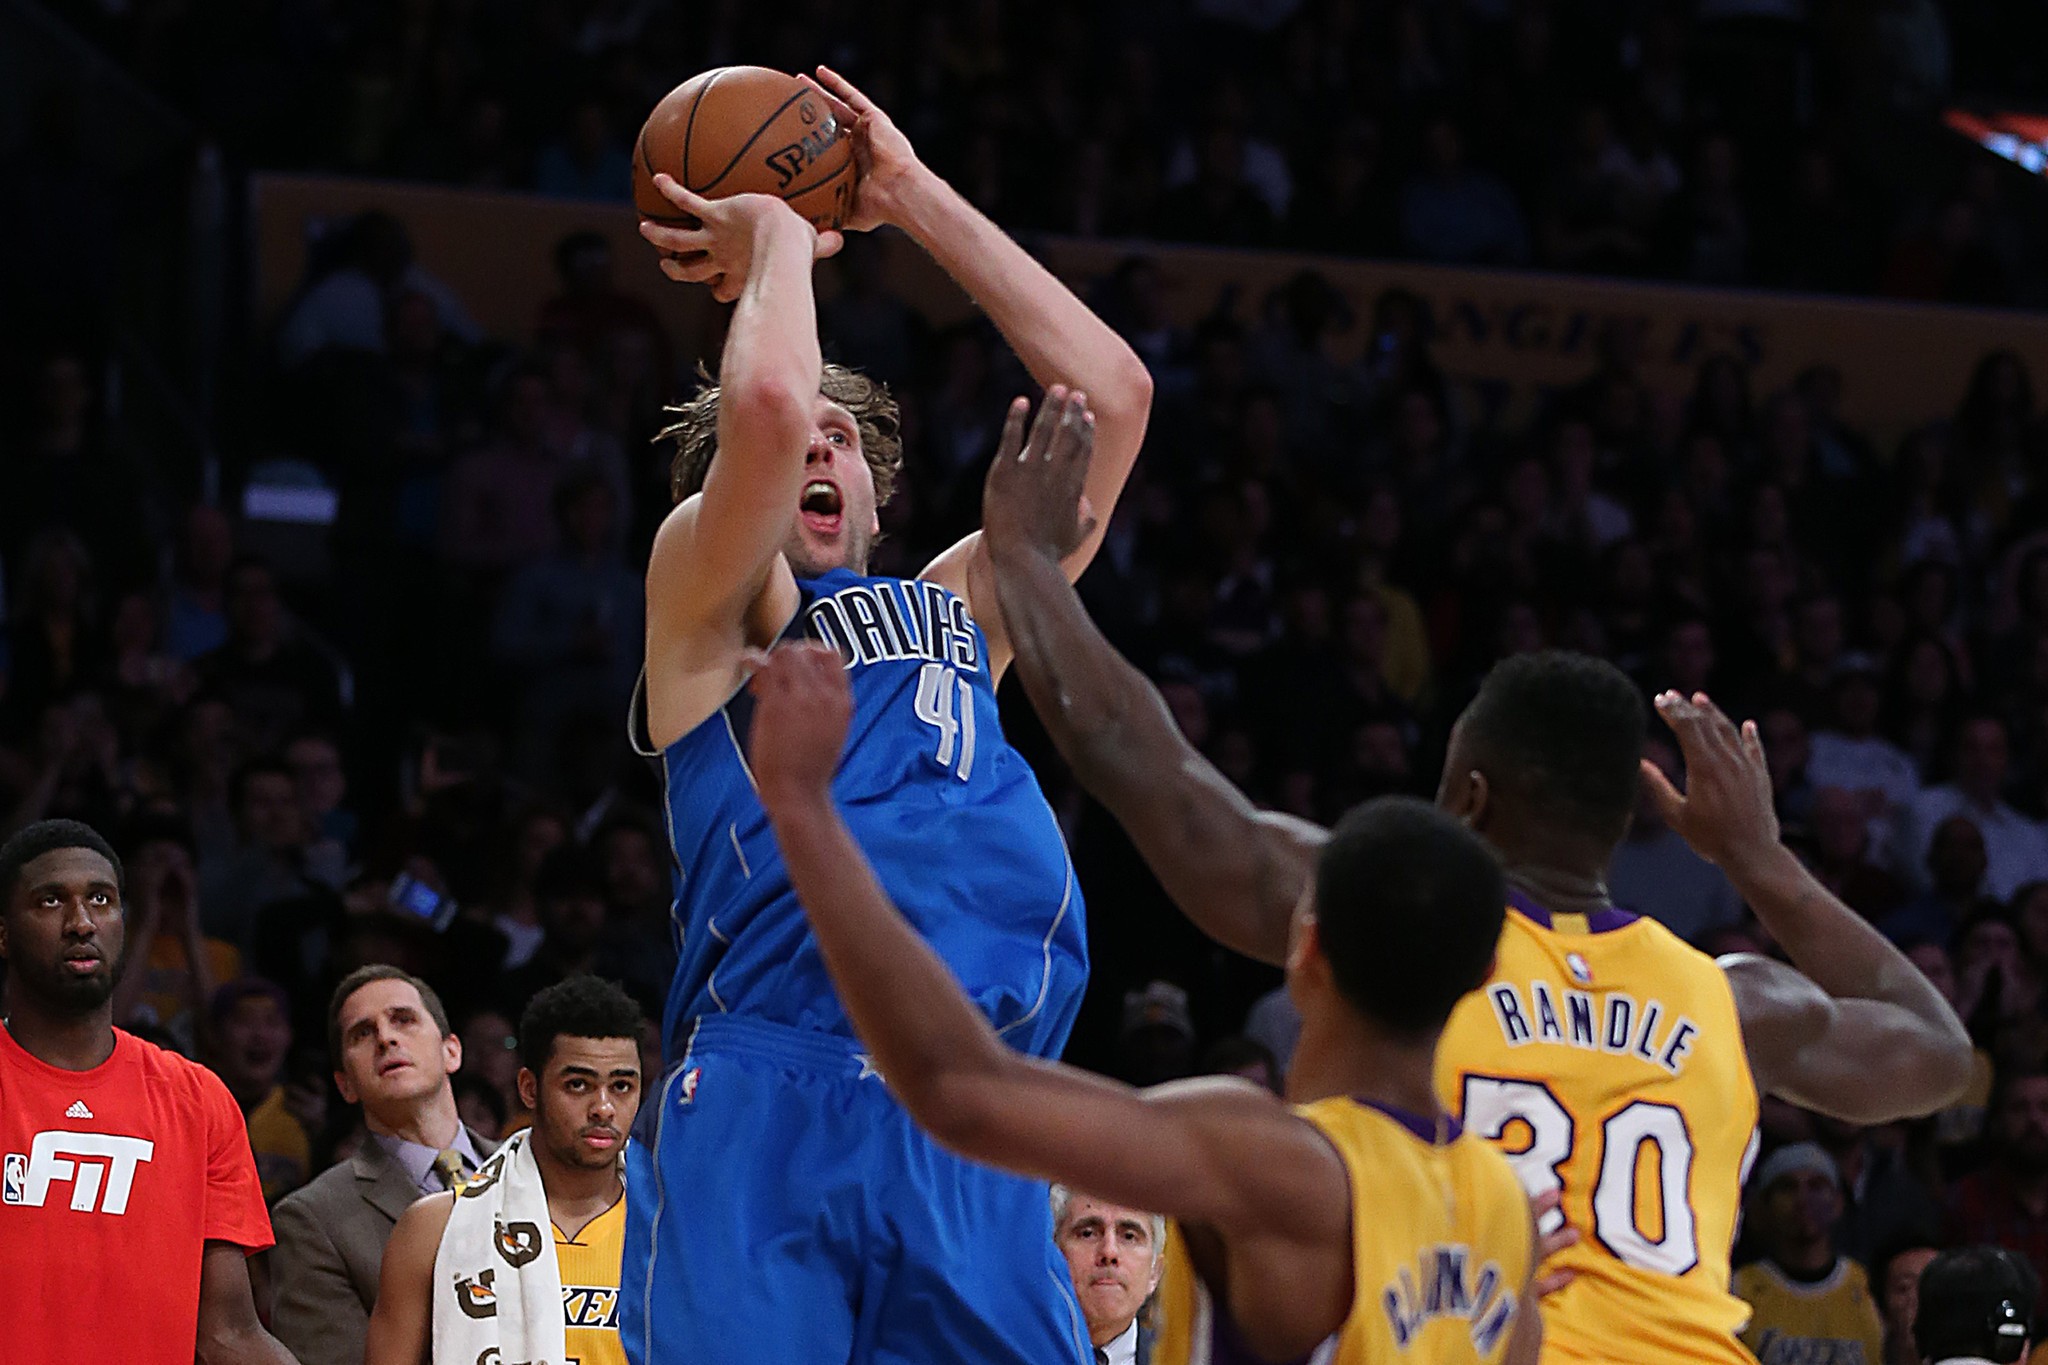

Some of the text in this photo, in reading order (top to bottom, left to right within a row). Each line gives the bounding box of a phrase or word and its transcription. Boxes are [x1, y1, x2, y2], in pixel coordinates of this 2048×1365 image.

[914, 662, 975, 782] 41
[1487, 981, 1699, 1075] RANDLE
[25, 1130, 154, 1215] FIT
[1462, 1074, 1699, 1276] 30
